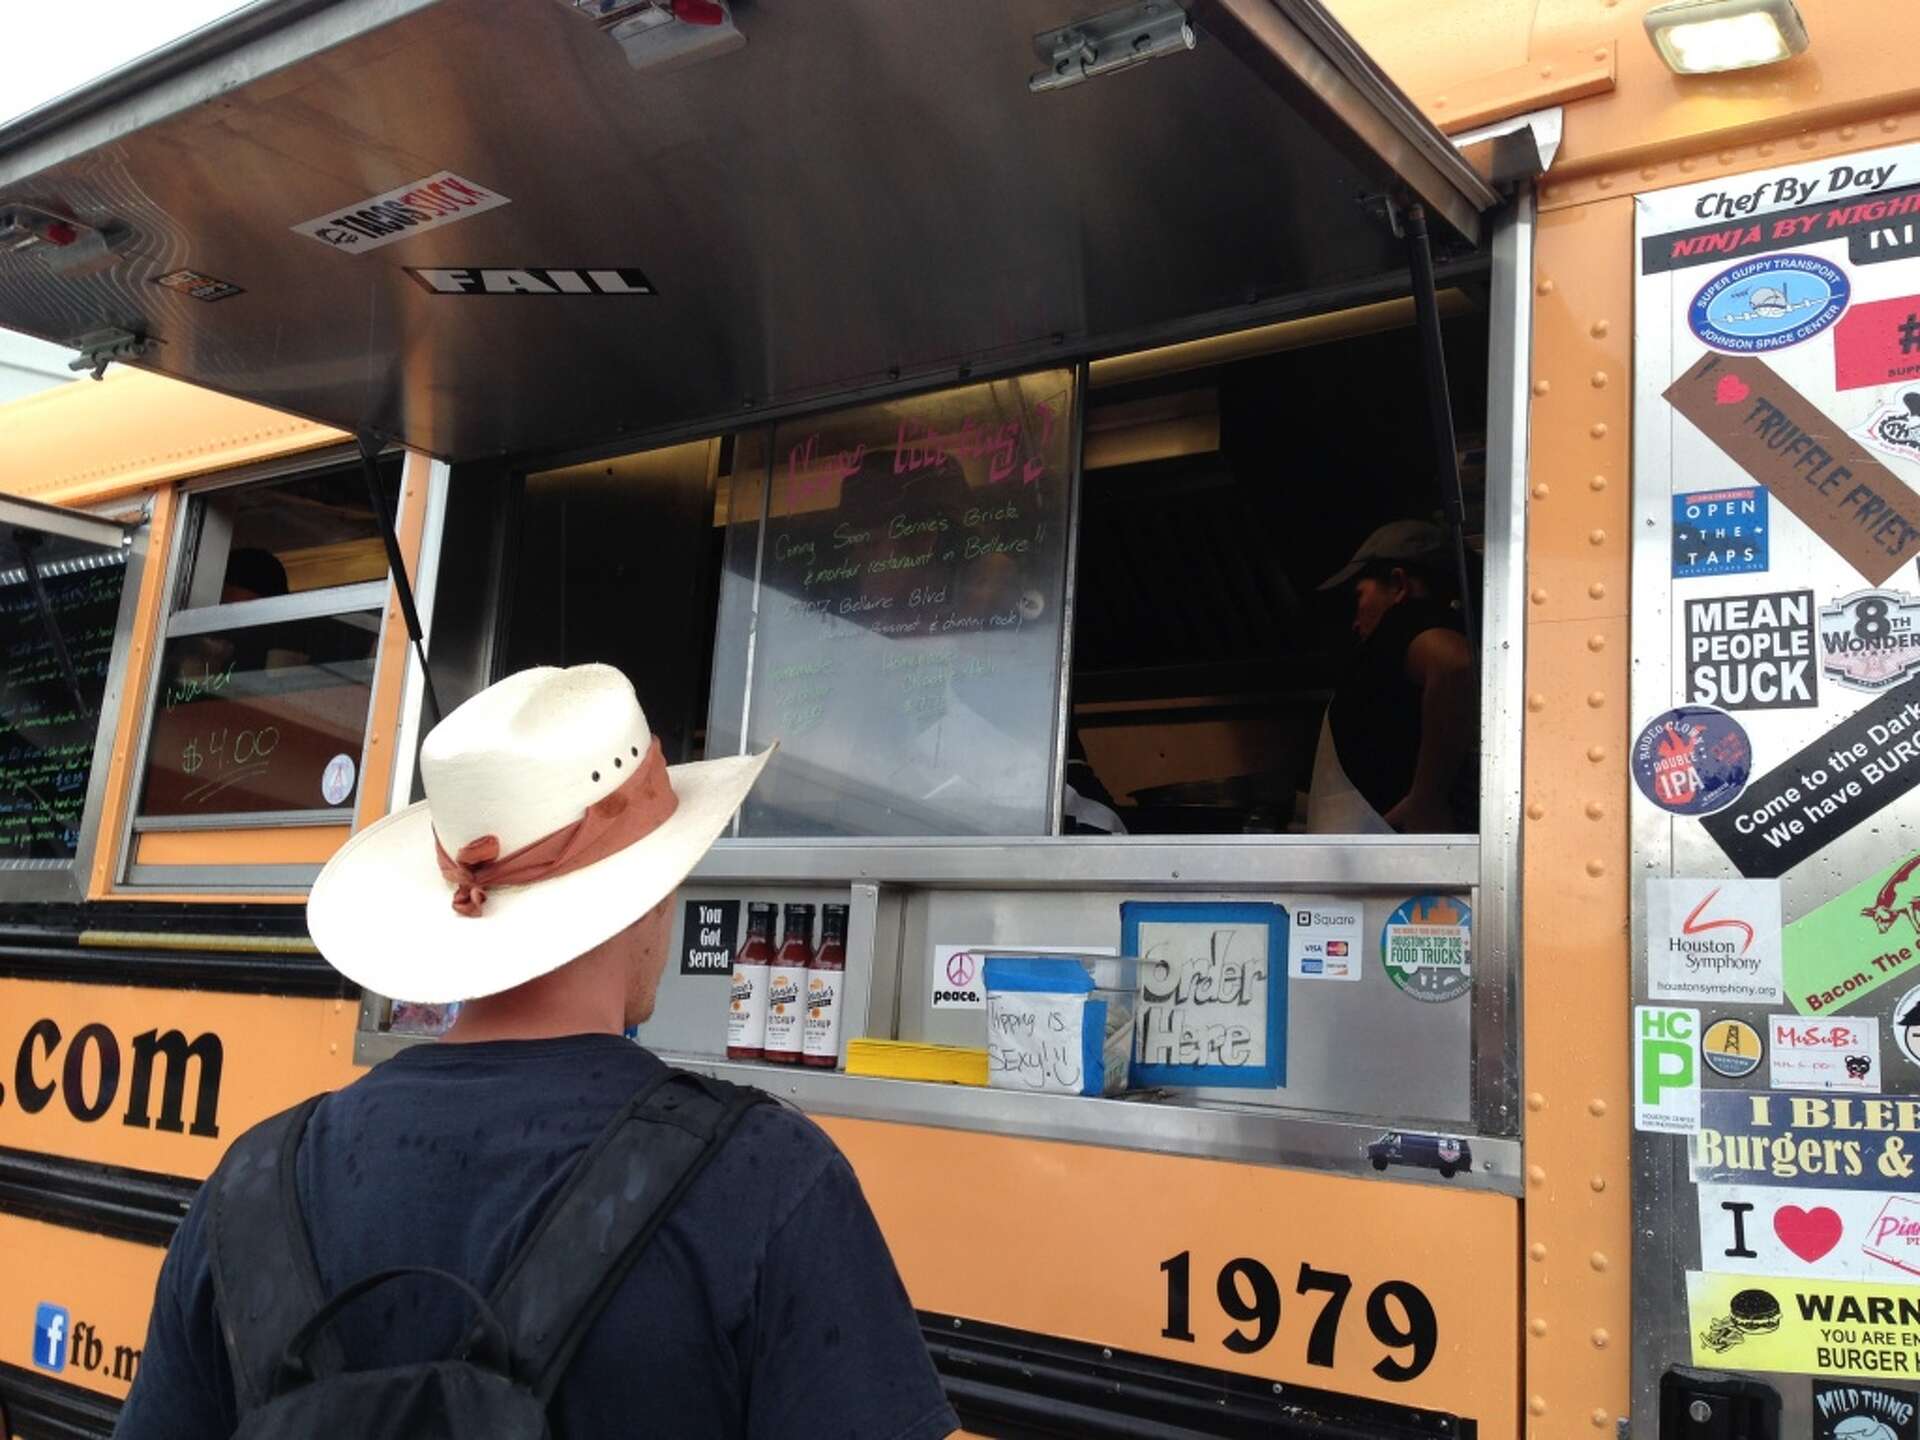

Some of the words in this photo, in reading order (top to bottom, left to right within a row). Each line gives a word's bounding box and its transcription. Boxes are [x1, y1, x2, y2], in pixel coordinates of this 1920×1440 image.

[1695, 182, 1772, 218] Chef
[1774, 177, 1820, 205] By
[1828, 163, 1898, 192] Day
[1671, 224, 1763, 258] NINJA
[1772, 214, 1822, 239] BY
[416, 270, 650, 293] FAIL
[1698, 275, 1731, 308] SUPER
[1731, 259, 1771, 281] GUPPY
[1773, 259, 1841, 285] TRANSPORT
[1700, 328, 1752, 349] JOHNSON
[1756, 332, 1795, 350] SPACE
[1797, 304, 1840, 338] CENTER
[1744, 396, 1852, 496] TRUFFLE
[1838, 484, 1919, 556] FRIES
[1686, 499, 1756, 519] OPEN
[1699, 526, 1742, 540] THE
[1687, 547, 1755, 566] TAPS
[1690, 595, 1809, 633] MEAN
[1692, 630, 1809, 662] PEOPLE
[1693, 660, 1811, 704] SUCK
[1653, 751, 1697, 773] DOUBLE
[1735, 786, 1802, 835] Come
[1801, 769, 1828, 791] to
[1828, 742, 1868, 773] the
[1867, 703, 1920, 746] Dark
[1660, 766, 1705, 799] IPA
[1762, 820, 1805, 849] We
[1803, 782, 1863, 824] have
[699, 905, 722, 925] You
[1313, 912, 1356, 927] Square
[700, 928, 721, 947] Got
[1669, 937, 1736, 954] Houston
[688, 948, 729, 969] Served
[1141, 929, 1267, 1006] Order
[1391, 949, 1417, 964] FOOD
[1421, 949, 1463, 965] TRUCKS
[1685, 953, 1761, 975] Symphony
[1657, 980, 1777, 997] houstonsymphony.org
[1806, 972, 1874, 1011] Bacon.
[1871, 948, 1912, 972] The
[933, 989, 980, 1005] peace.
[1138, 1004, 1250, 1067] Here
[1642, 1010, 1693, 1040] HC
[1642, 1040, 1693, 1105] P
[1750, 1096, 1772, 1127] I
[1701, 1127, 1862, 1178] Burgers
[1878, 1136, 1914, 1178] &
[1721, 1201, 1757, 1258] I
[1160, 1250, 1438, 1382] 1979
[1796, 1293, 1920, 1325] WARN
[1820, 1329, 1857, 1343] YOU
[1862, 1331, 1897, 1345] ARE
[1817, 1347, 1909, 1373] BURGER
[1816, 1388, 1859, 1419] MILD
[1860, 1389, 1914, 1426] THING
